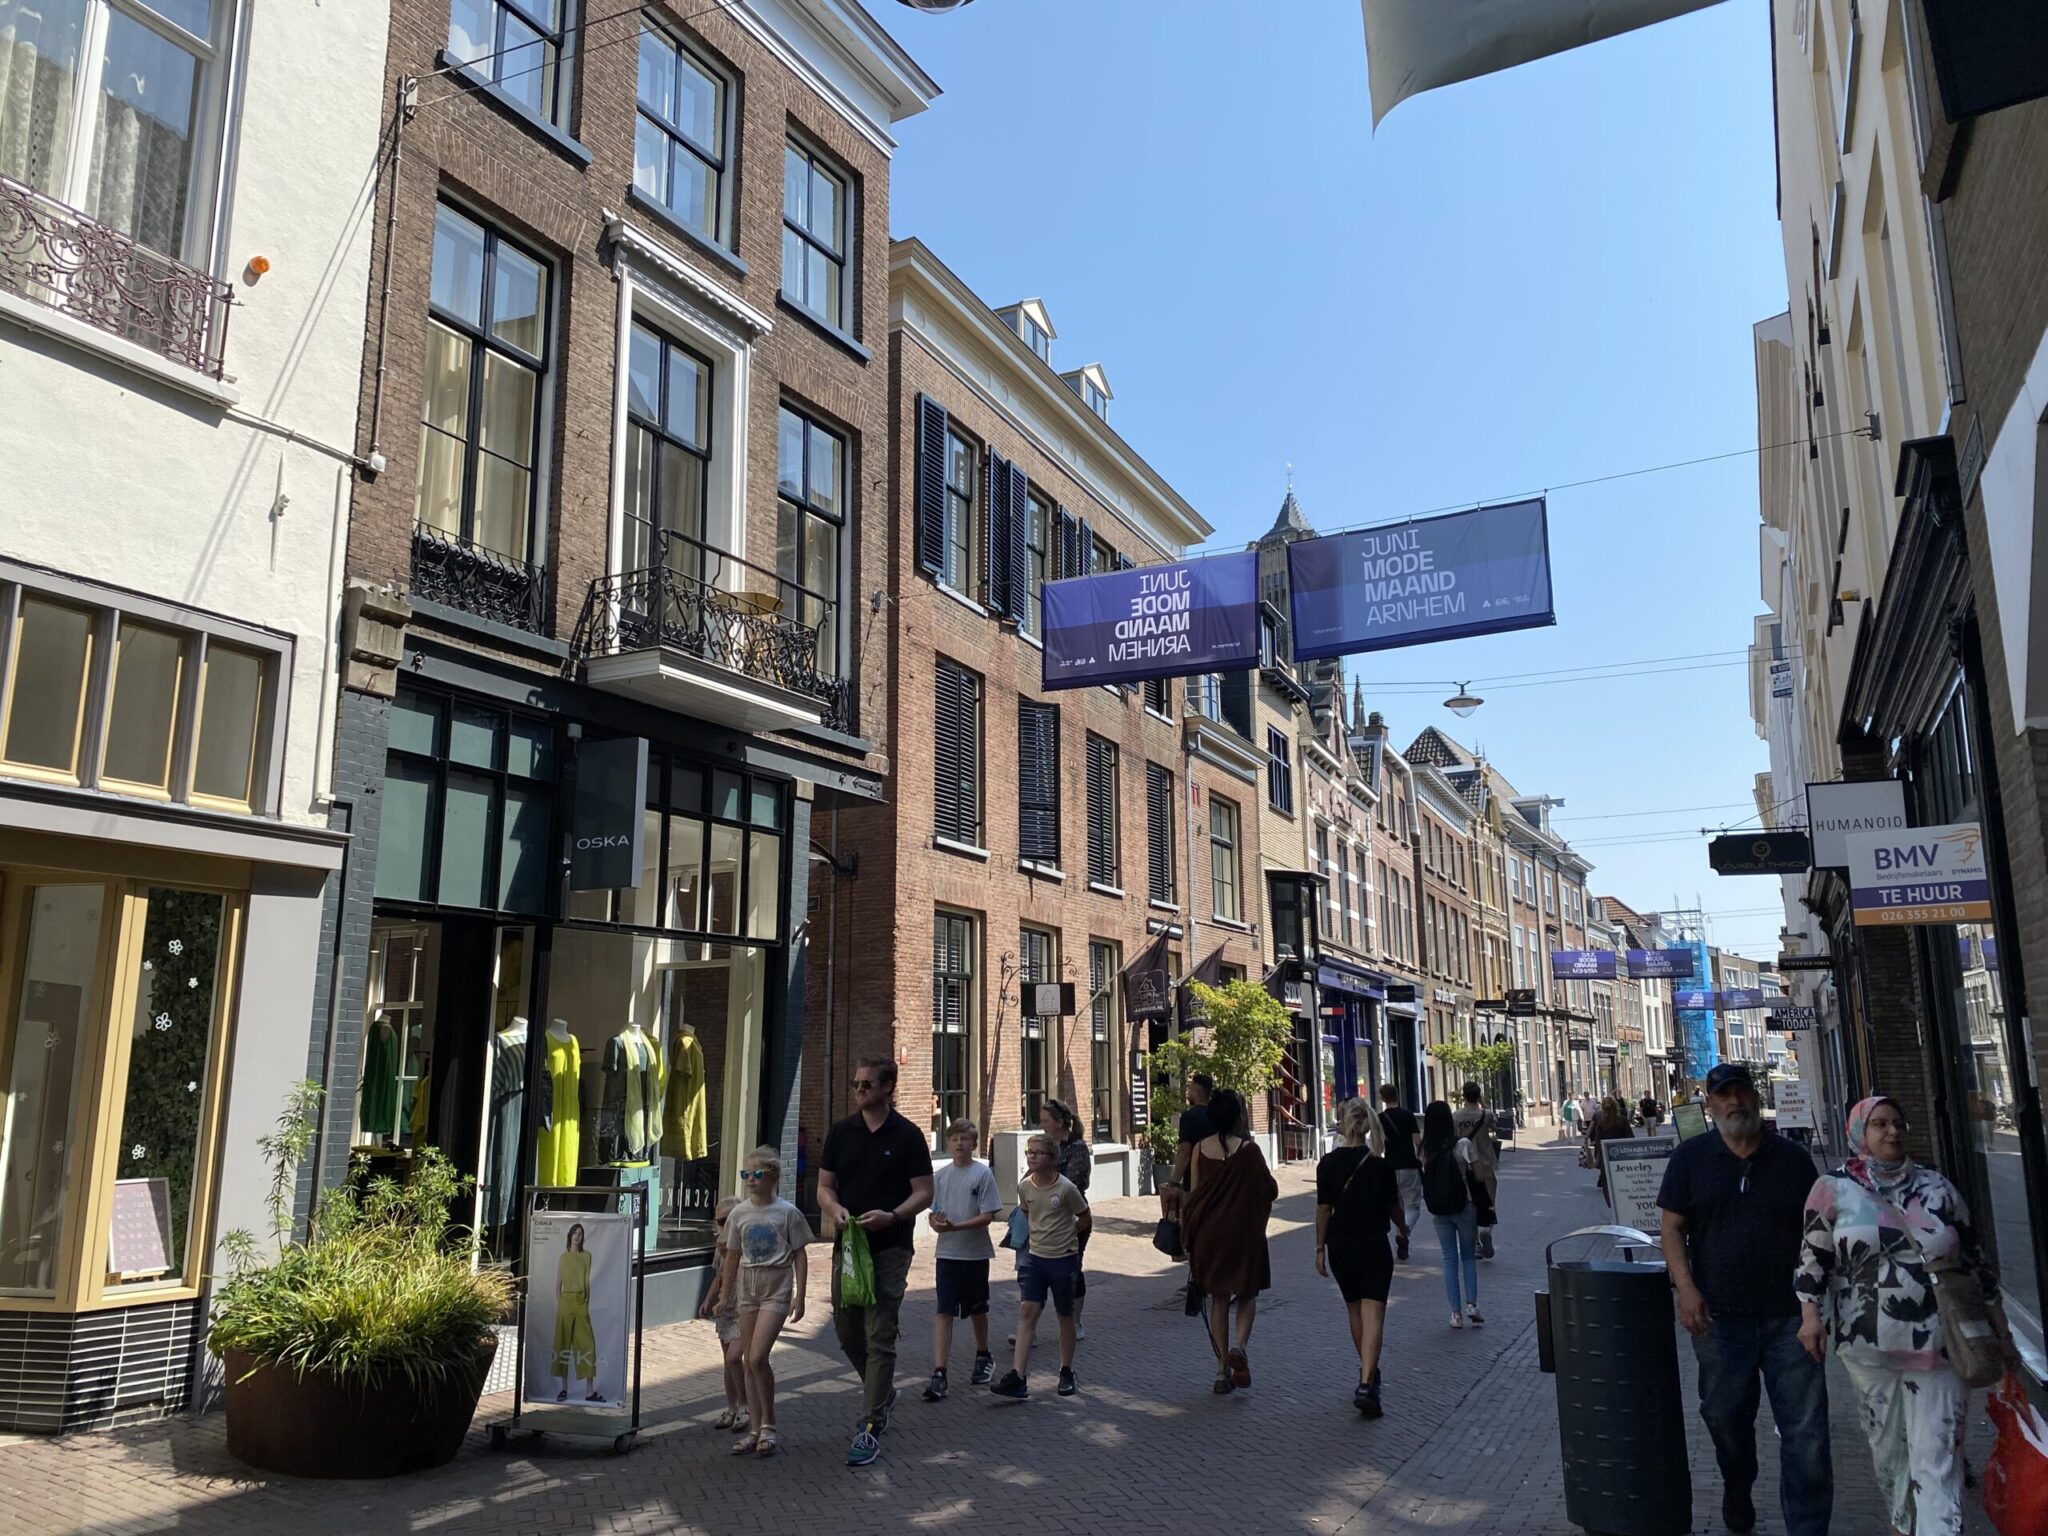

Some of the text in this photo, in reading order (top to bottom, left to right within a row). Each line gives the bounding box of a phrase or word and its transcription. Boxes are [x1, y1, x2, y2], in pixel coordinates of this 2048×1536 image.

[1361, 529, 1421, 558] JUNI
[1363, 551, 1435, 580] MODE
[1365, 571, 1456, 603] MAAND
[1366, 592, 1466, 626] ARNHEM
[1816, 816, 1903, 831] HUMANOID
[577, 835, 629, 850] OSKA
[1874, 844, 1939, 870] BMV
[1717, 862, 1765, 870] LOVABLE
[1951, 867, 1983, 875] DYNAMIS
[1876, 870, 1943, 882] Bedrijfsmakelaars
[1878, 885, 1963, 904] TE HUUR
[1881, 907, 1965, 921] 026 355 21 00
[1774, 1008, 1815, 1018] AMERICA
[1782, 1019, 1809, 1030] TODAY
[1615, 1163, 1652, 1173] Jewelry
[1636, 1202, 1656, 1210] YOU
[540, 1350, 609, 1367] OSKA
